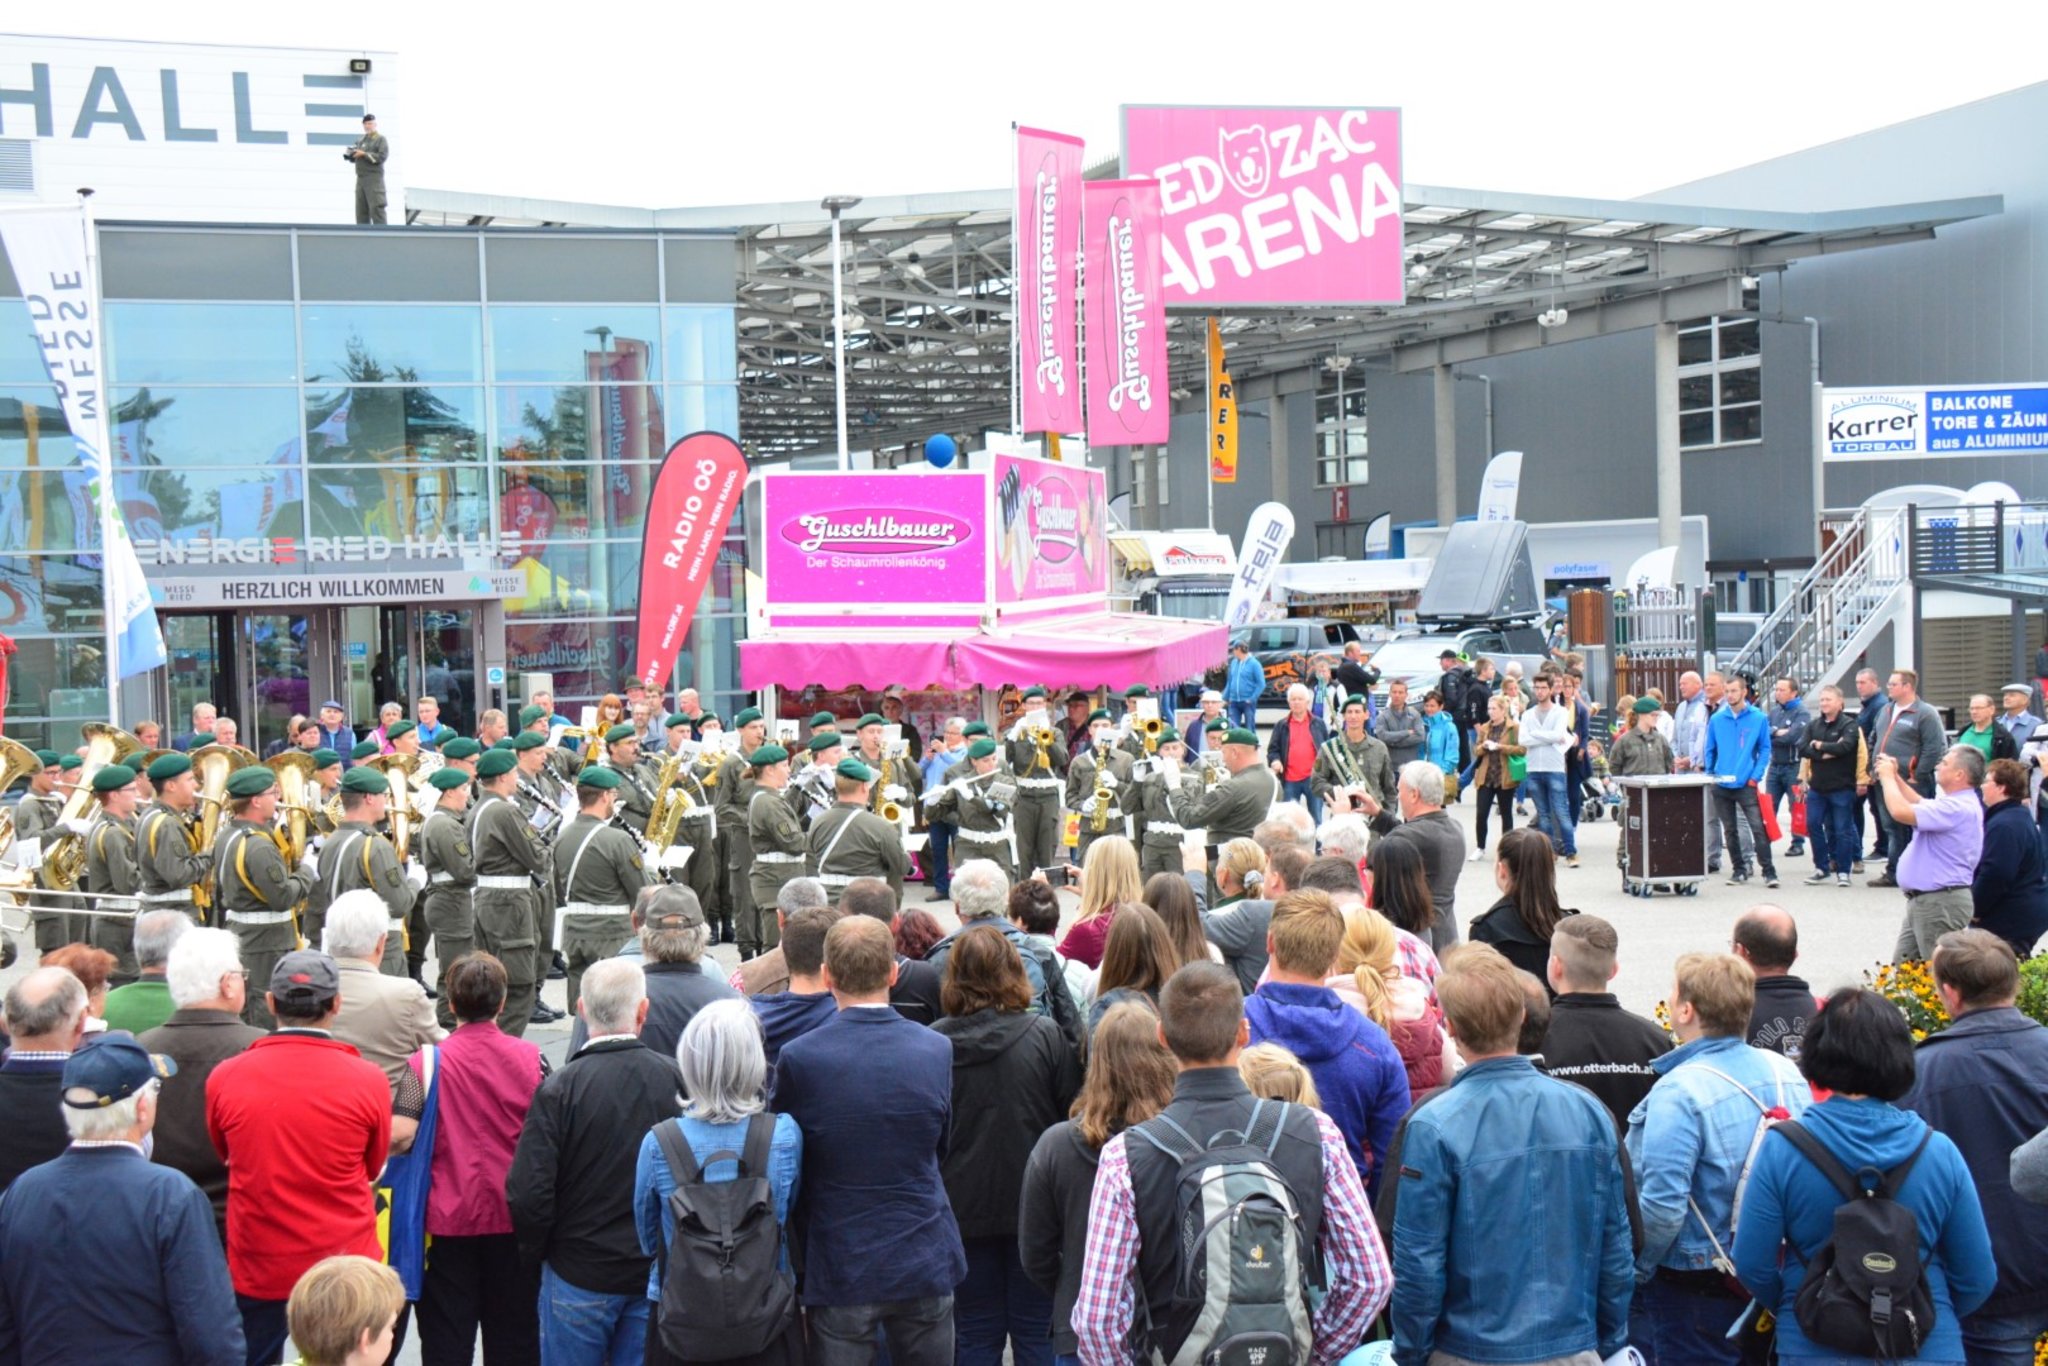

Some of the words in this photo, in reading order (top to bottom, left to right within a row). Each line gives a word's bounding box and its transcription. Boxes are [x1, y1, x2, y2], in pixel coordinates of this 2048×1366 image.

[0, 62, 364, 145] HALLE
[1128, 156, 1224, 216] ED
[1269, 110, 1376, 179] ZAC
[1831, 395, 1918, 412] ALUMINIUM
[1931, 395, 2013, 411] BALKONE
[1828, 412, 1918, 441] Karrer
[1932, 416, 1978, 430] TORE
[1984, 416, 1995, 428] &
[1834, 442, 1914, 452] TORBAU
[1932, 437, 1960, 449] aus
[662, 495, 702, 569] RADIO
[799, 515, 957, 552] Guschlbauer
[133, 537, 297, 564] ENERGIE
[307, 535, 392, 562] RIED
[405, 531, 522, 560] HALLE
[806, 557, 827, 568] Der
[222, 581, 312, 600] HERZLICH
[319, 578, 444, 597] WILLKOMMEN
[491, 577, 520, 585] MESSE
[495, 585, 516, 593] RIED
[164, 585, 196, 594] MESSE
[1548, 1061, 1654, 1077] www.otterbach.at
